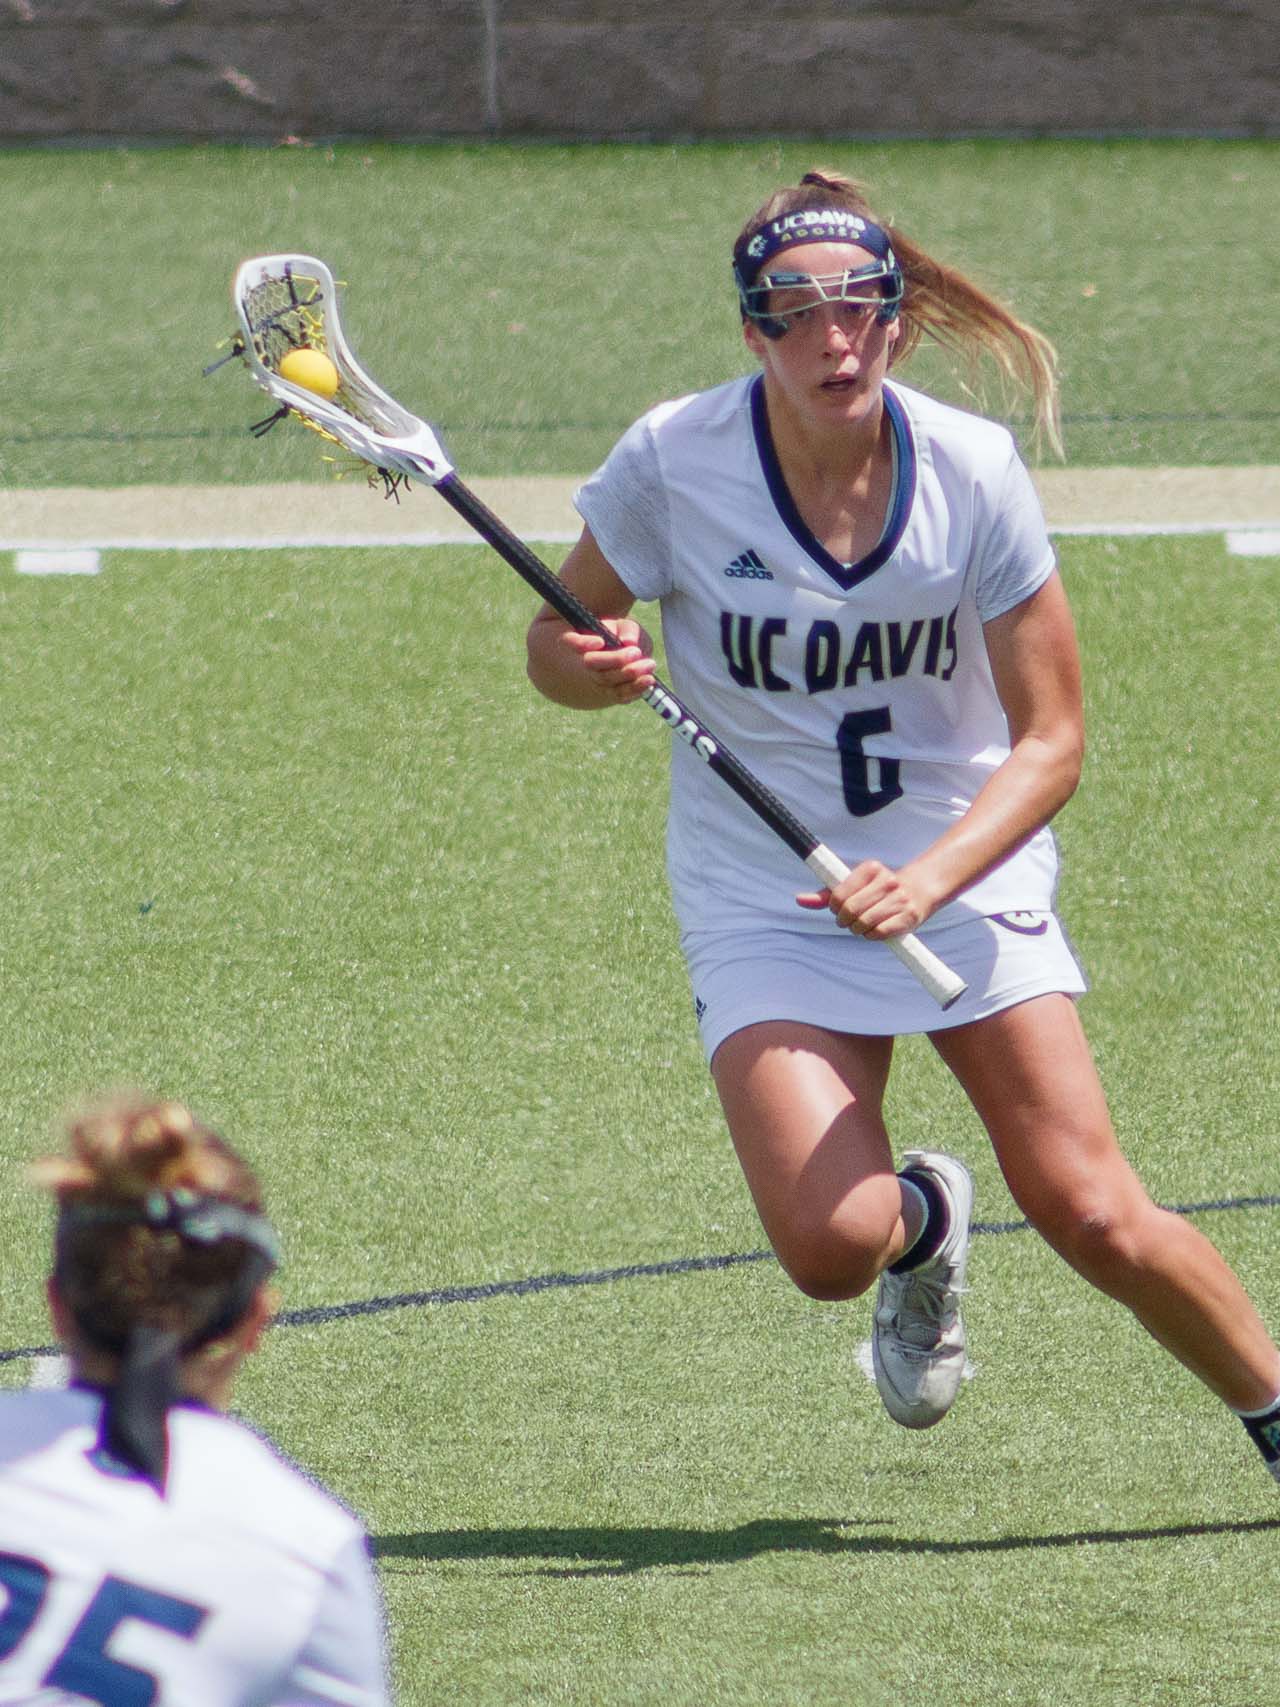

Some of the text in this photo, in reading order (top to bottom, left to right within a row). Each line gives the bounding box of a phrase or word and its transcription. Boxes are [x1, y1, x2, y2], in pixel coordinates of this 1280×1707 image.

[724, 566, 774, 580] adidas
[720, 601, 960, 695] UC DAVIS
[641, 685, 718, 764] IDAS
[836, 705, 904, 818] 6
